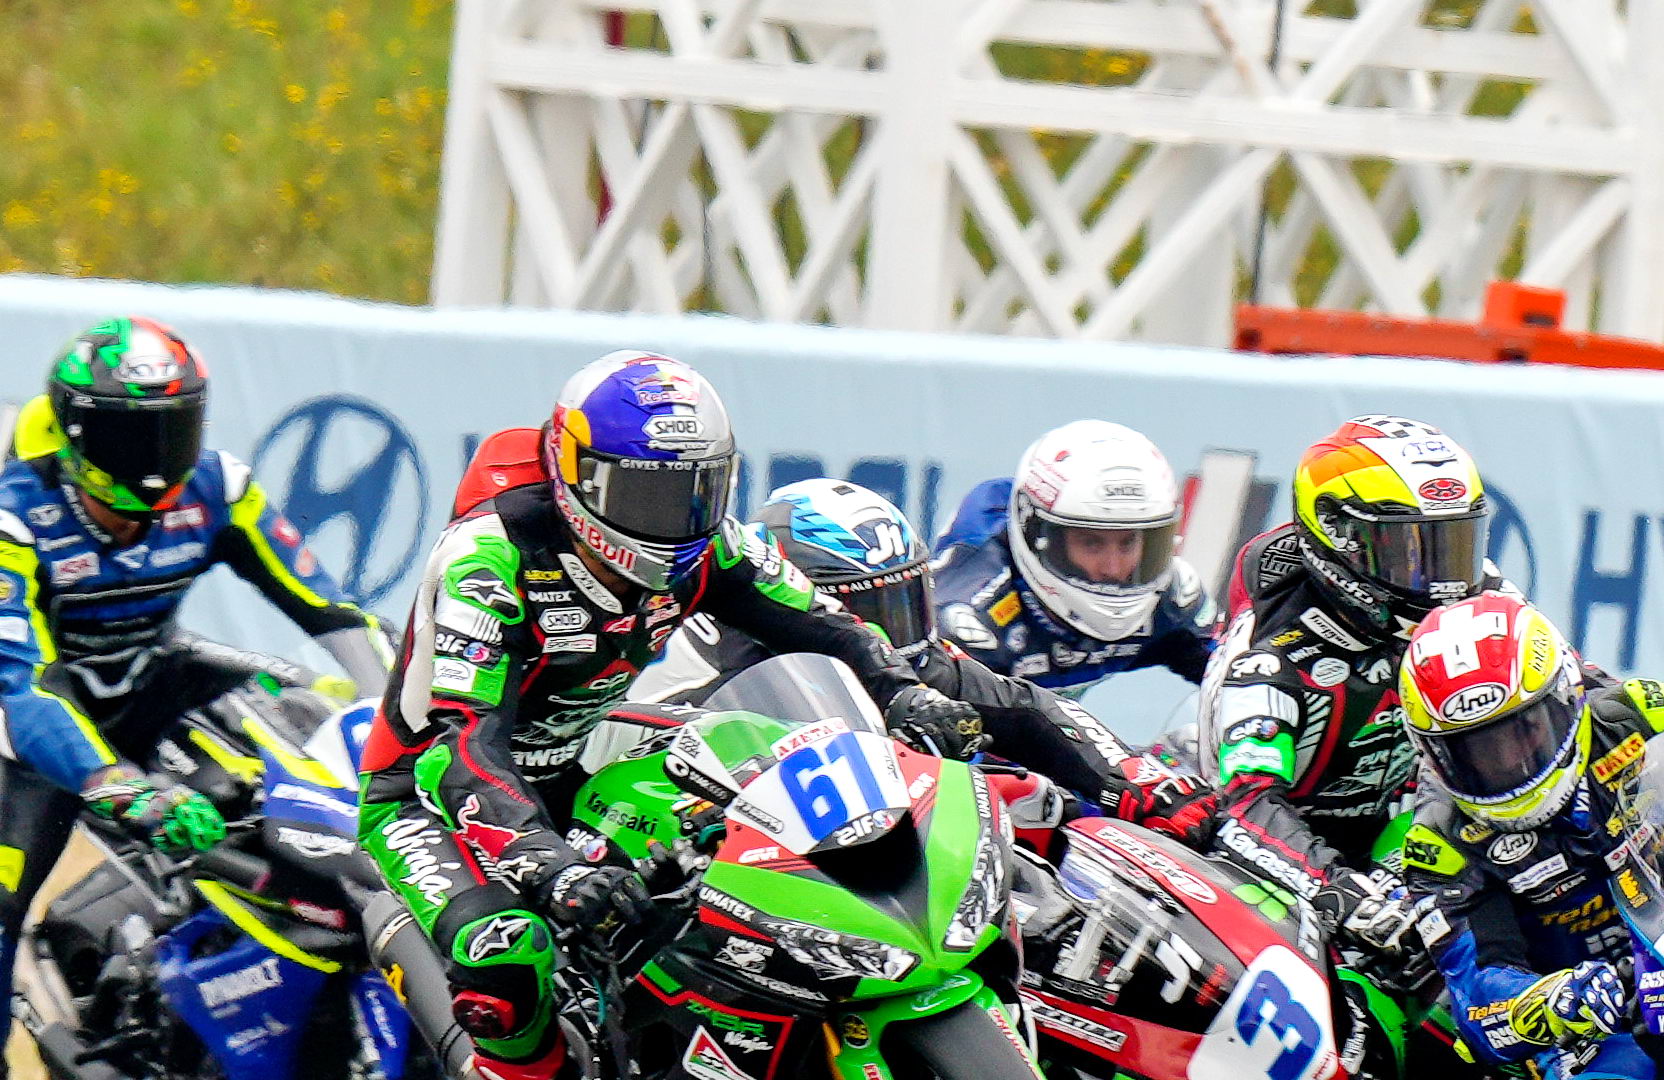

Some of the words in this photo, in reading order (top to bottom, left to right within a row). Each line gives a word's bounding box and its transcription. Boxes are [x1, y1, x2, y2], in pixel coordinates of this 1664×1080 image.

[587, 526, 636, 569] Bull
[1446, 690, 1498, 718] Arai
[779, 731, 889, 842] 61
[586, 791, 659, 837] Kawasaki
[381, 817, 454, 906] Ninja
[1216, 817, 1323, 902] Kawasaki
[1493, 833, 1534, 860] Arai
